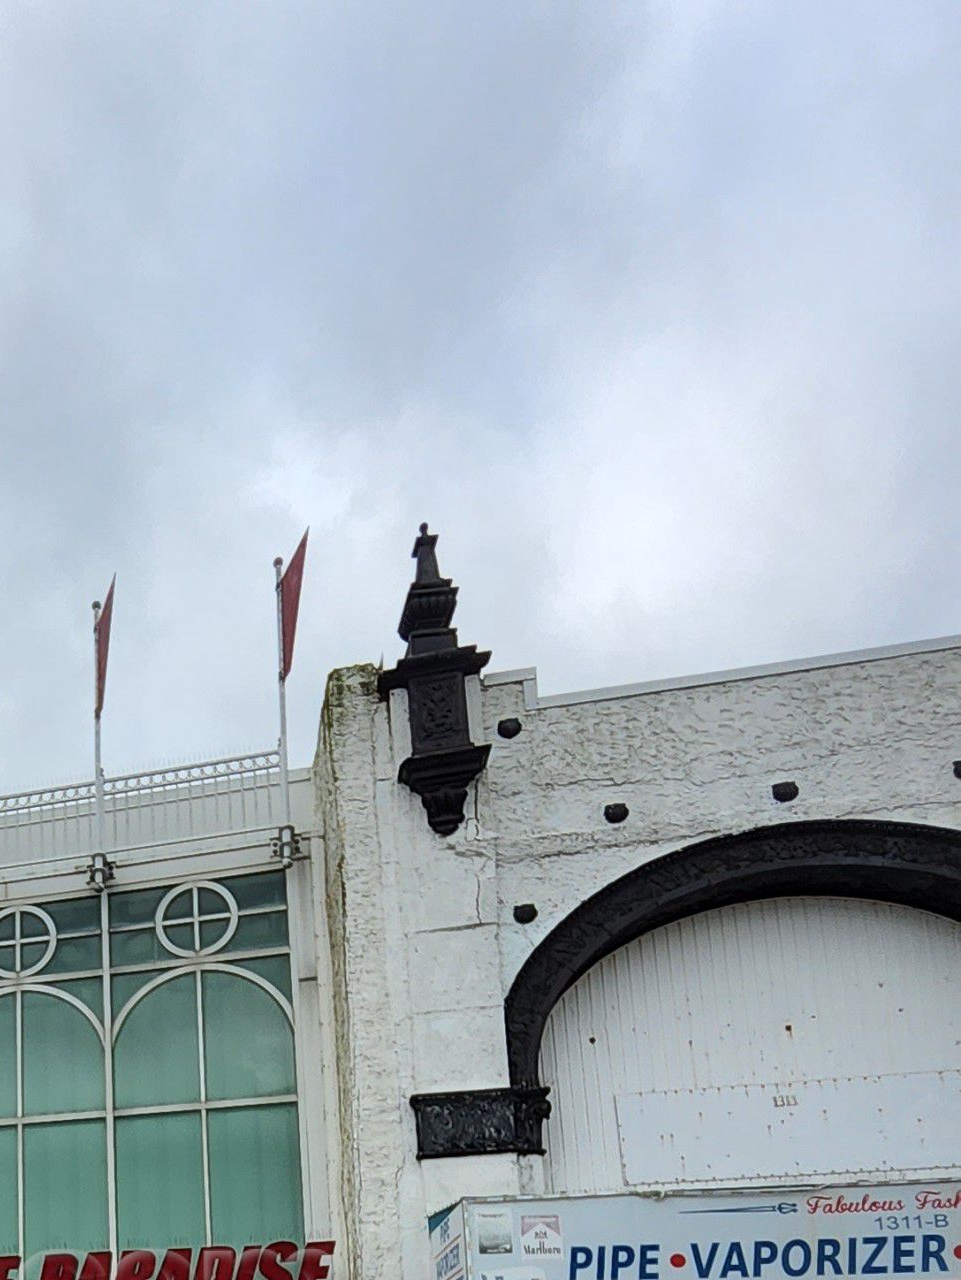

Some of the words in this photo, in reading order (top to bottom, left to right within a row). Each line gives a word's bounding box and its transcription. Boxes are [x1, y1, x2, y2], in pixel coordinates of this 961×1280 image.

[806, 1193, 905, 1214] Fabulous
[874, 1214, 949, 1230] 1311-B
[690, 1234, 949, 1279] VAPORIZER
